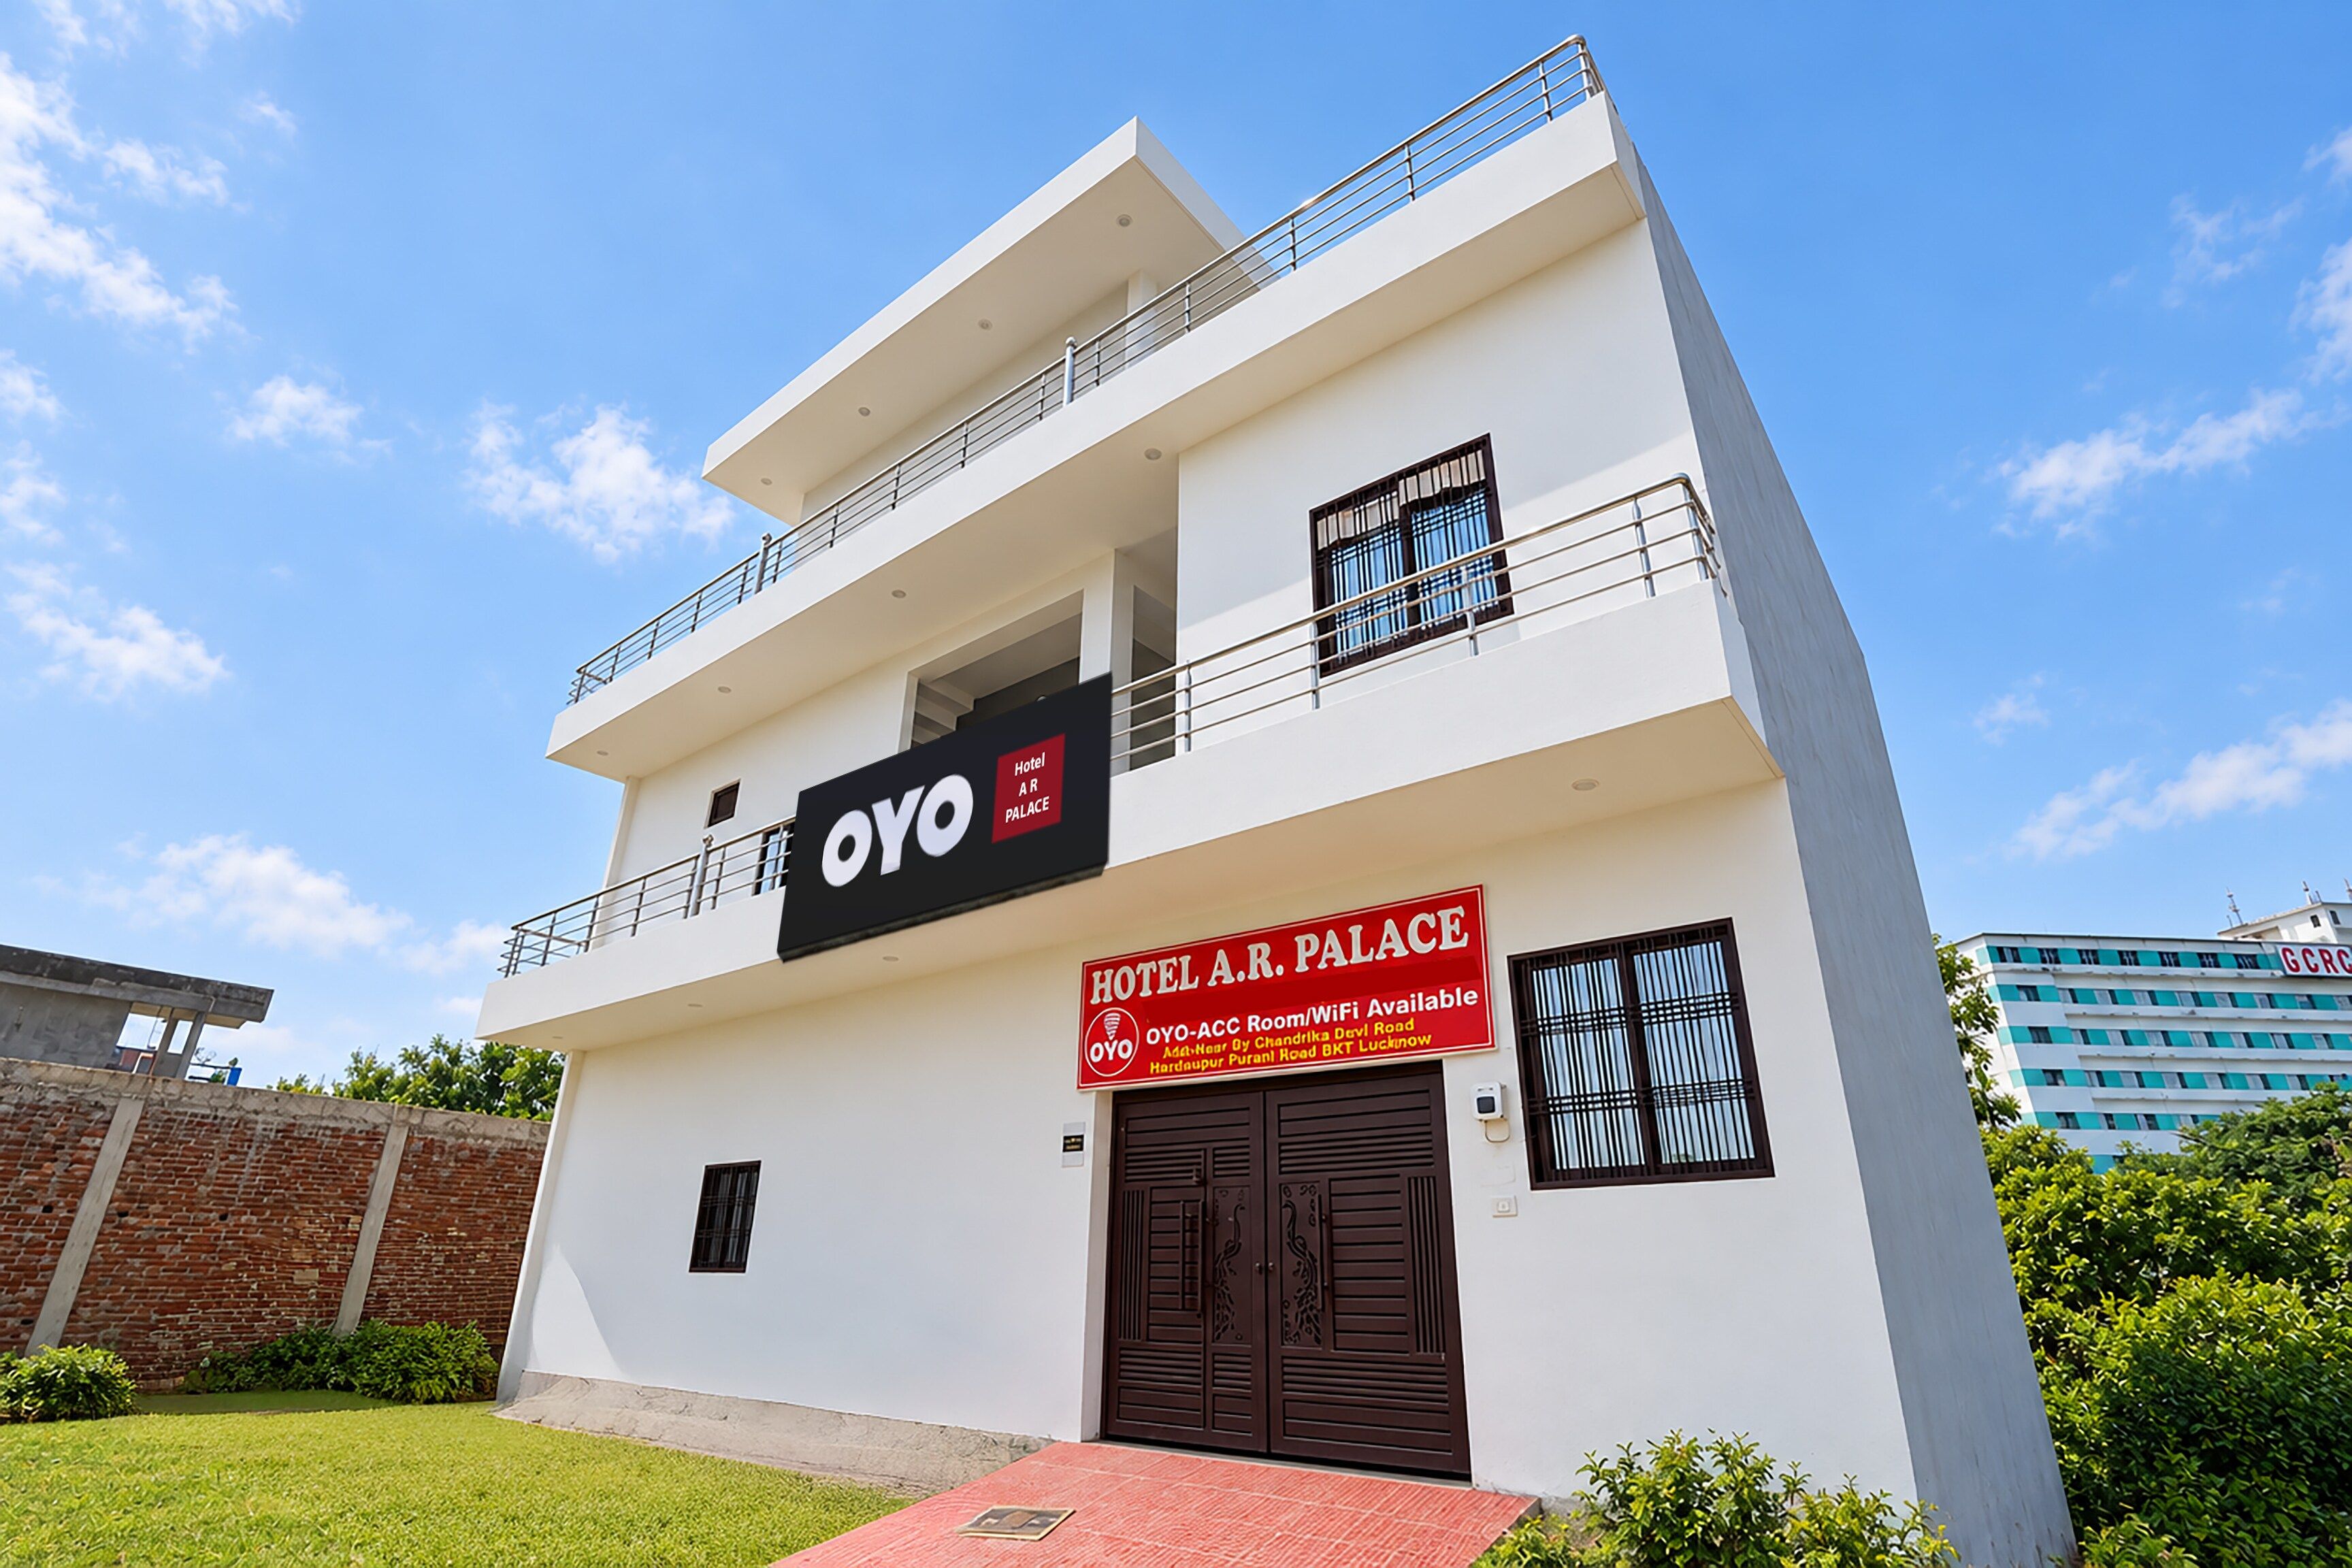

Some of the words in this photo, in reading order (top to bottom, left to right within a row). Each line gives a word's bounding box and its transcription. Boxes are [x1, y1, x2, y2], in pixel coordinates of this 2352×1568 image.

[1014, 752, 1045, 777] Hotel
[1019, 780, 1027, 796] A
[1030, 778, 1038, 793] R
[1005, 796, 1049, 823] PALACE
[821, 774, 974, 887] OYO
[1090, 954, 1199, 1004] HOTEL
[1207, 942, 1284, 987] A.R.
[1294, 905, 1469, 972] PALACE
[2281, 947, 2352, 974] GCRC
[1146, 1017, 1241, 1045] OYO-ACC
[1367, 987, 1478, 1018] Available
[1374, 1017, 1415, 1036] Road
[1090, 1039, 1132, 1062] OYO
[1279, 1045, 1316, 1062] Road
[1322, 1041, 1354, 1057] BKT
[1359, 1034, 1432, 1053] Lucknow
